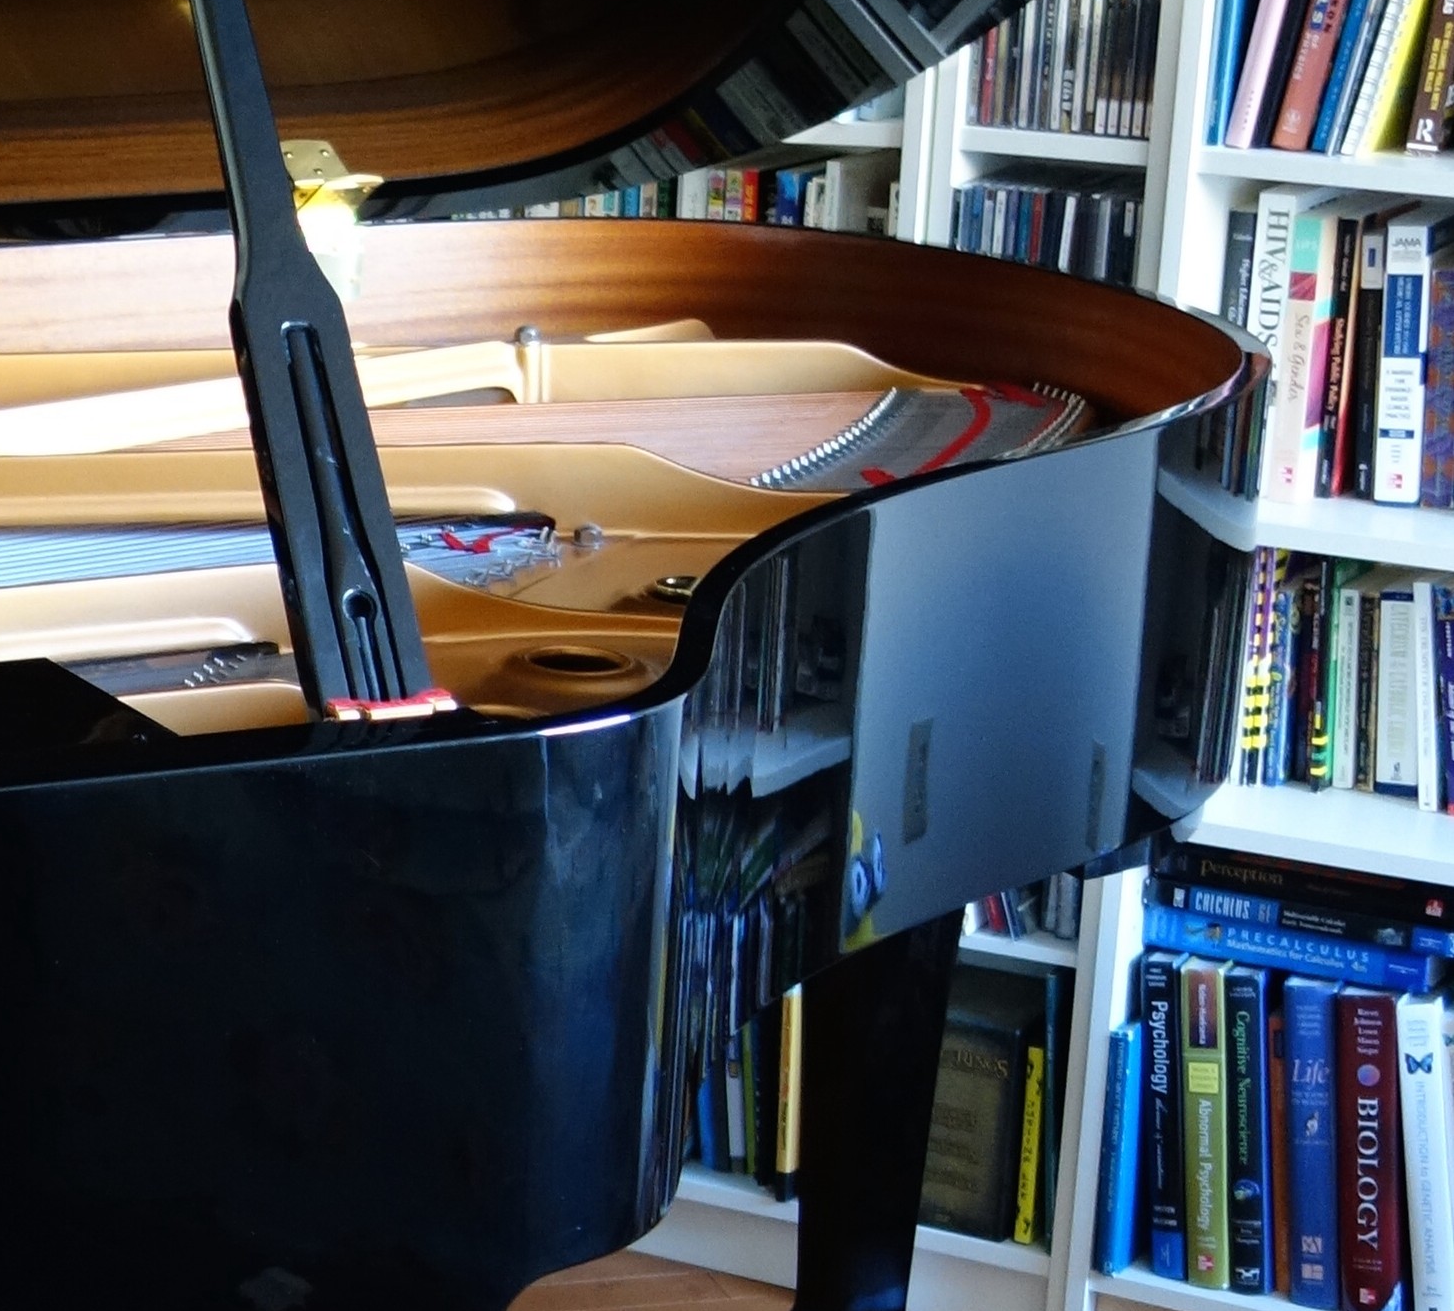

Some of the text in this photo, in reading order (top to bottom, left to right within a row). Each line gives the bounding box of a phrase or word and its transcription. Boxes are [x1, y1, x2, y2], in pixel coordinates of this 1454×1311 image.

[1392, 238, 1422, 248] JAMA
[1296, 314, 1311, 338] Sex
[1287, 354, 1306, 403] Gender
[1325, 318, 1345, 412] Studying Public Policy
[1200, 859, 1284, 885] Perception
[1195, 891, 1252, 920] CALCULUS
[1226, 939, 1288, 959] Mathematics
[1289, 948, 1304, 962] for
[1305, 951, 1345, 970] Calculus
[1227, 927, 1371, 964] PRECALCULUS
[1148, 1000, 1170, 1095] Psychology
[1231, 1010, 1251, 1075] Cognitive
[1291, 1058, 1330, 1090] Life
[1198, 1099, 1213, 1158] Abnormal
[1236, 1077, 1252, 1166] Neuroscience
[1415, 1081, 1429, 1165] INTRODUCTION
[1197, 1161, 1213, 1232] Psychology
[1356, 1096, 1380, 1251] BIOLOGY
[1421, 1180, 1435, 1224] GENETIC
